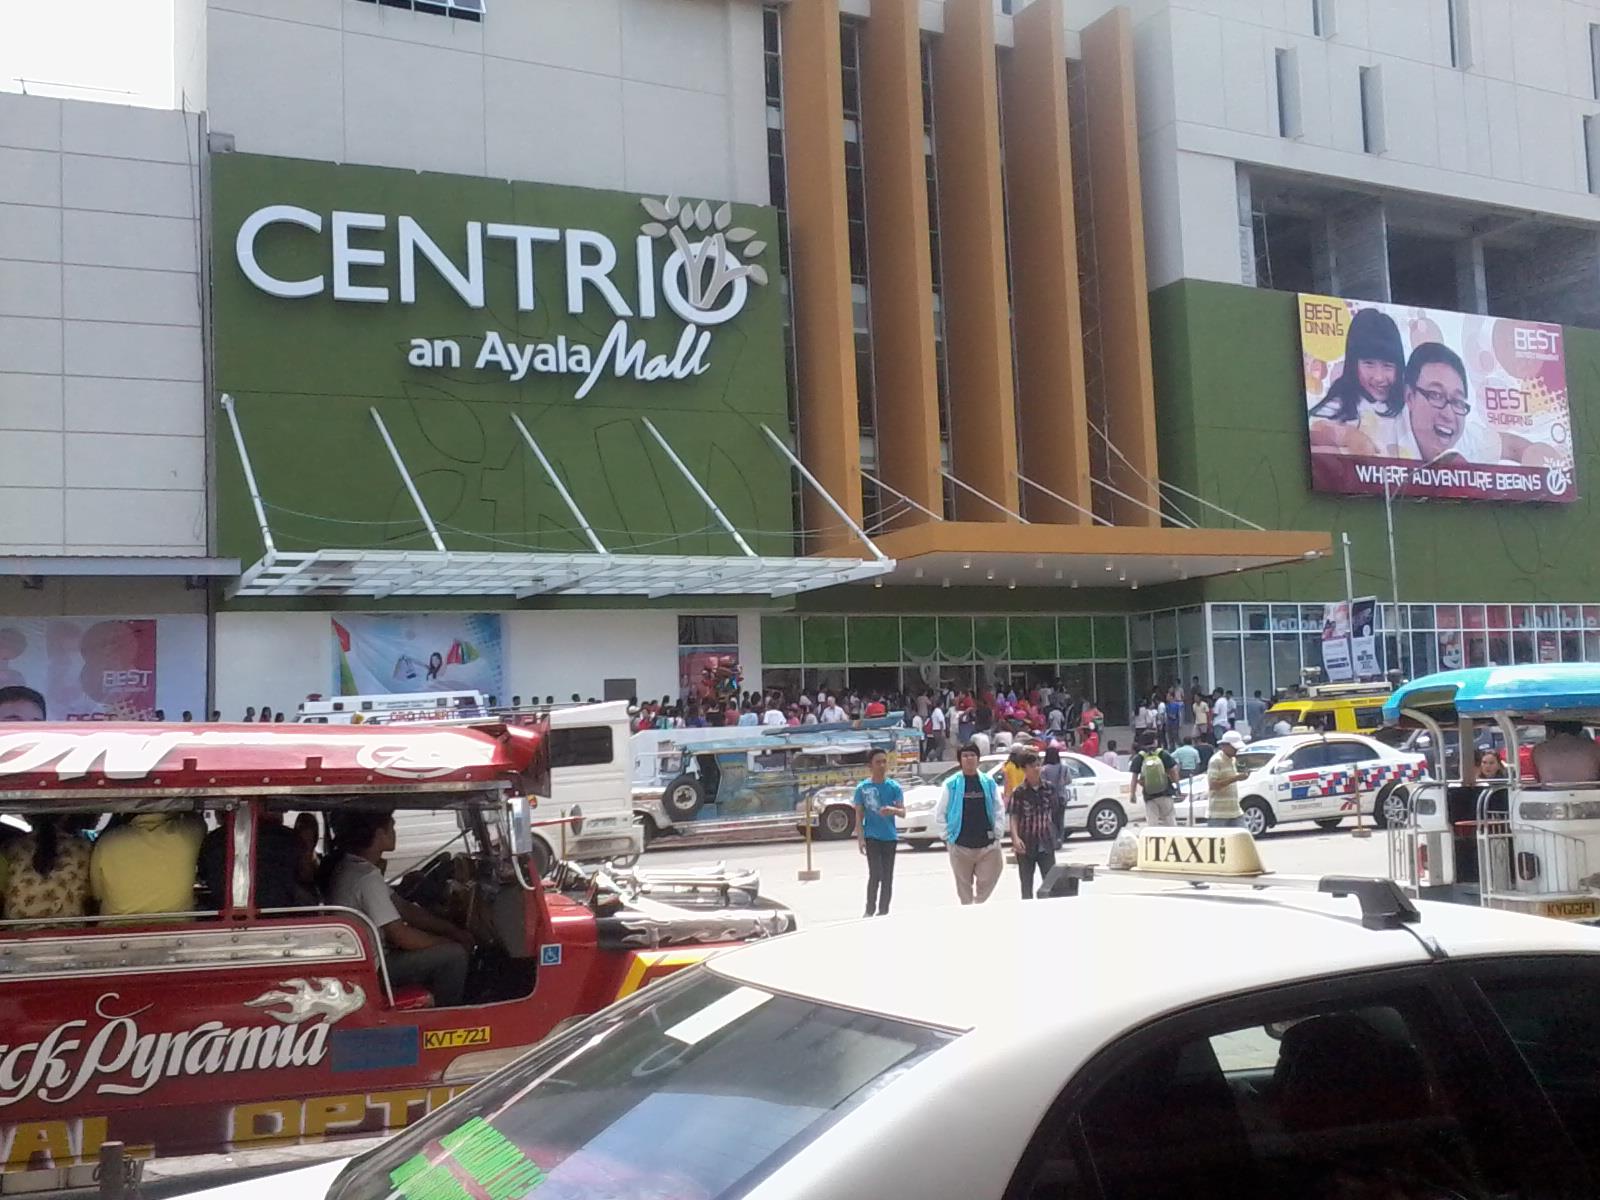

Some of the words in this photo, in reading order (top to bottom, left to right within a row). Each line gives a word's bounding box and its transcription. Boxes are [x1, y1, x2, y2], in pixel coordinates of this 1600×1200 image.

[236, 204, 748, 325] CENTRIO
[1304, 302, 1342, 323] BEST
[1514, 327, 1560, 354] BEST
[408, 336, 460, 368] an
[475, 331, 591, 381] Ayala
[574, 319, 711, 400] Mall
[1485, 387, 1531, 413] BEST
[1412, 467, 1493, 491] ADVENTURE
[1495, 473, 1542, 492] BEGINS
[1518, 606, 1598, 629] Jollbee
[103, 669, 152, 687] BEST
[1149, 836, 1218, 864] TAXI
[424, 1028, 487, 1048] KVT-721
